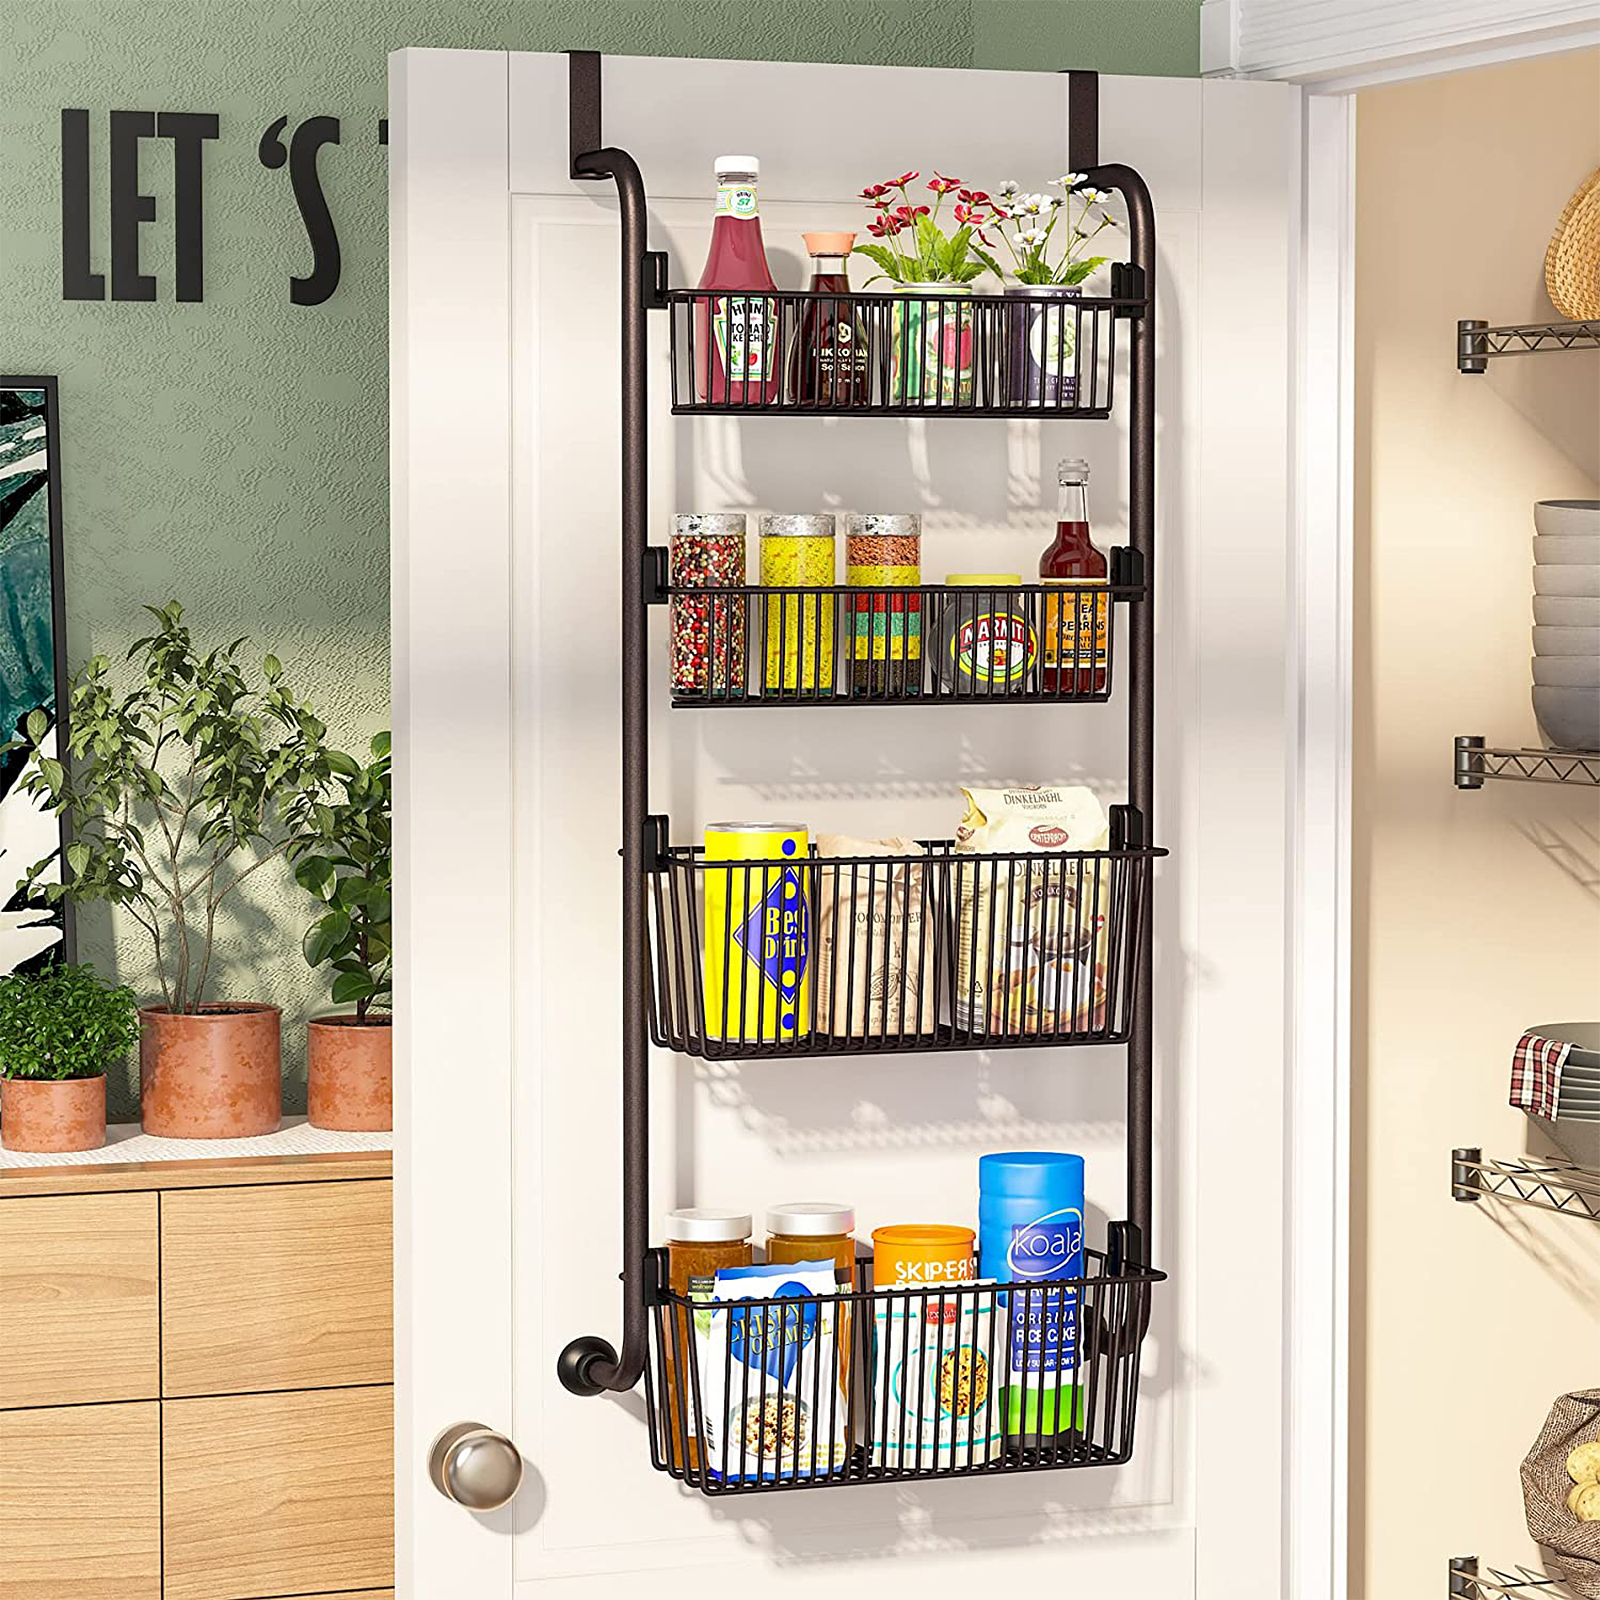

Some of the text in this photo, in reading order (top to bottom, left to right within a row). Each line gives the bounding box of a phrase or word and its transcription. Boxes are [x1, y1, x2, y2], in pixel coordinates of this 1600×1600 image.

[61, 109, 219, 303] LET
[737, 198, 751, 206] 57
[731, 302, 766, 317] HEIN
[731, 323, 771, 334] TOATO
[732, 334, 770, 343] KECHP
[964, 619, 1030, 645] MARMIT
[1061, 621, 1105, 631] PERNS
[1003, 792, 1063, 805] DINKELMEHL
[1014, 861, 1091, 877] DINKELEL
[765, 936, 806, 959] Dink
[1016, 1310, 1075, 1325] ORIGIA
[751, 1318, 833, 1355] OATMEL
[1016, 1327, 1042, 1343] RCE
